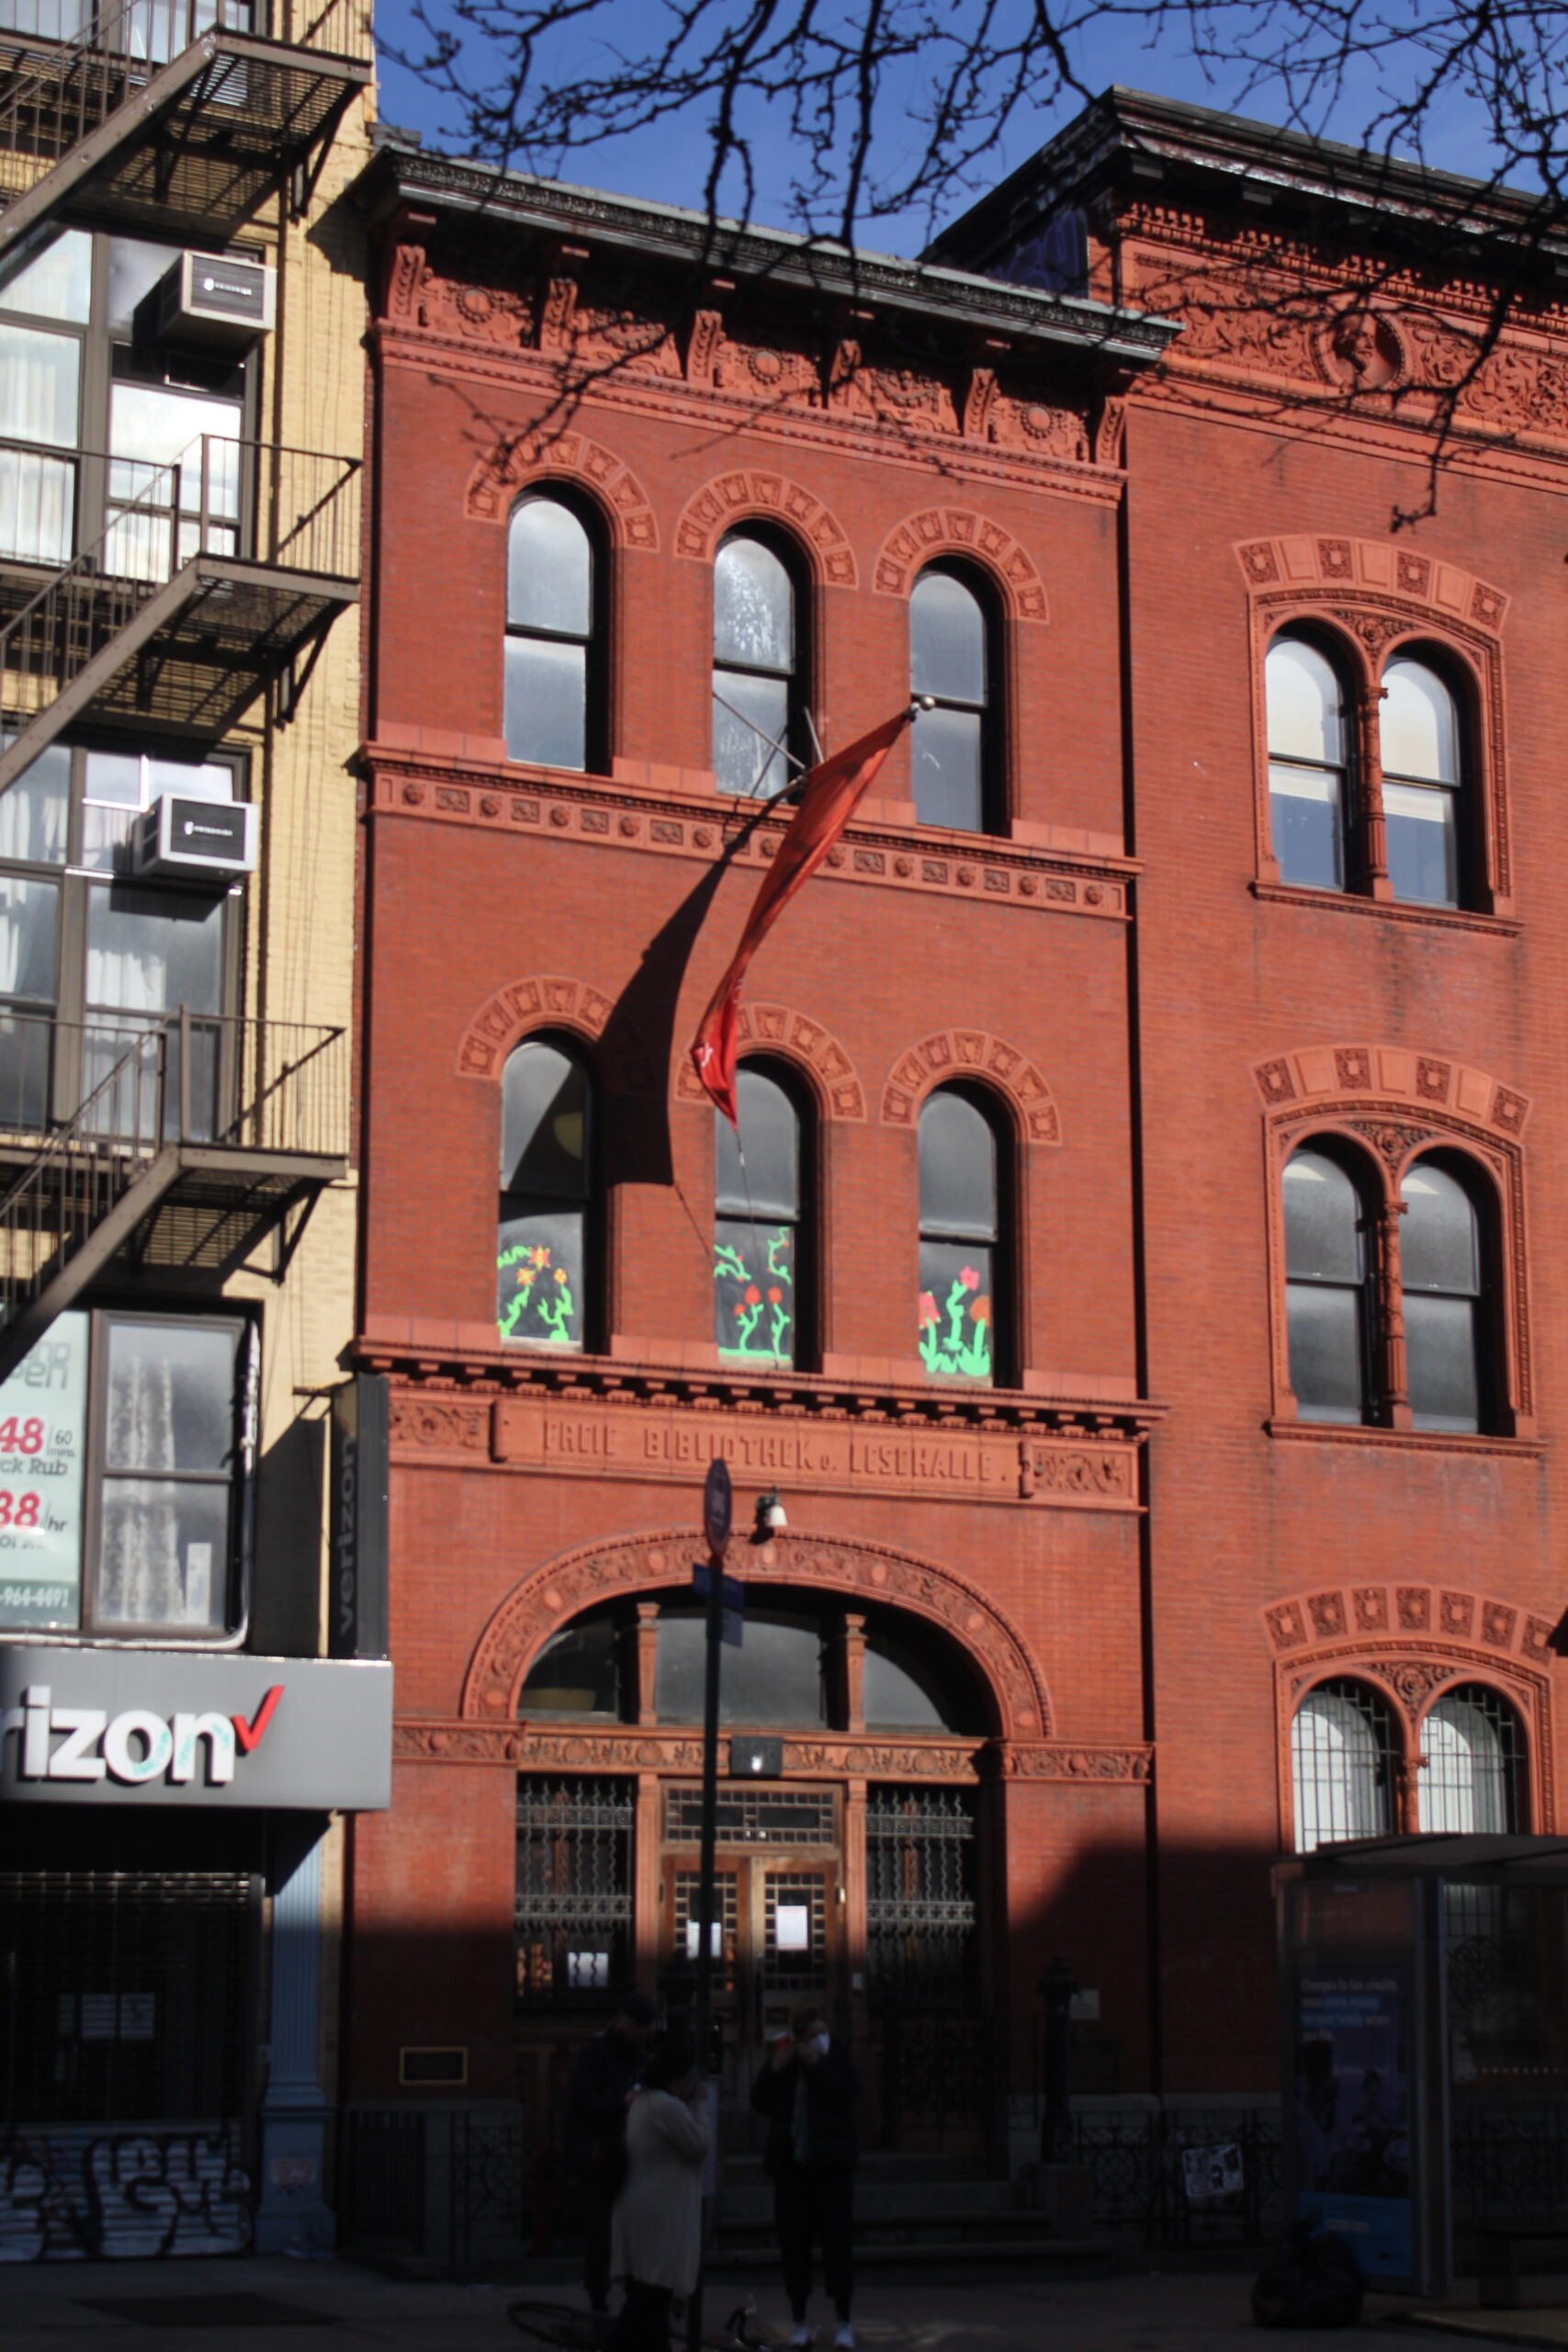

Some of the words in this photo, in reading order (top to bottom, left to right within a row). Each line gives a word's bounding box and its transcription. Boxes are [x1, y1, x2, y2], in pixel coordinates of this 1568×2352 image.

[0, 1416, 44, 1454] 48
[543, 1419, 618, 1457] FREIE
[643, 1427, 814, 1471] BIBLIOTHEK
[29, 1458, 69, 1476] Rub
[337, 1436, 355, 1636] verizon
